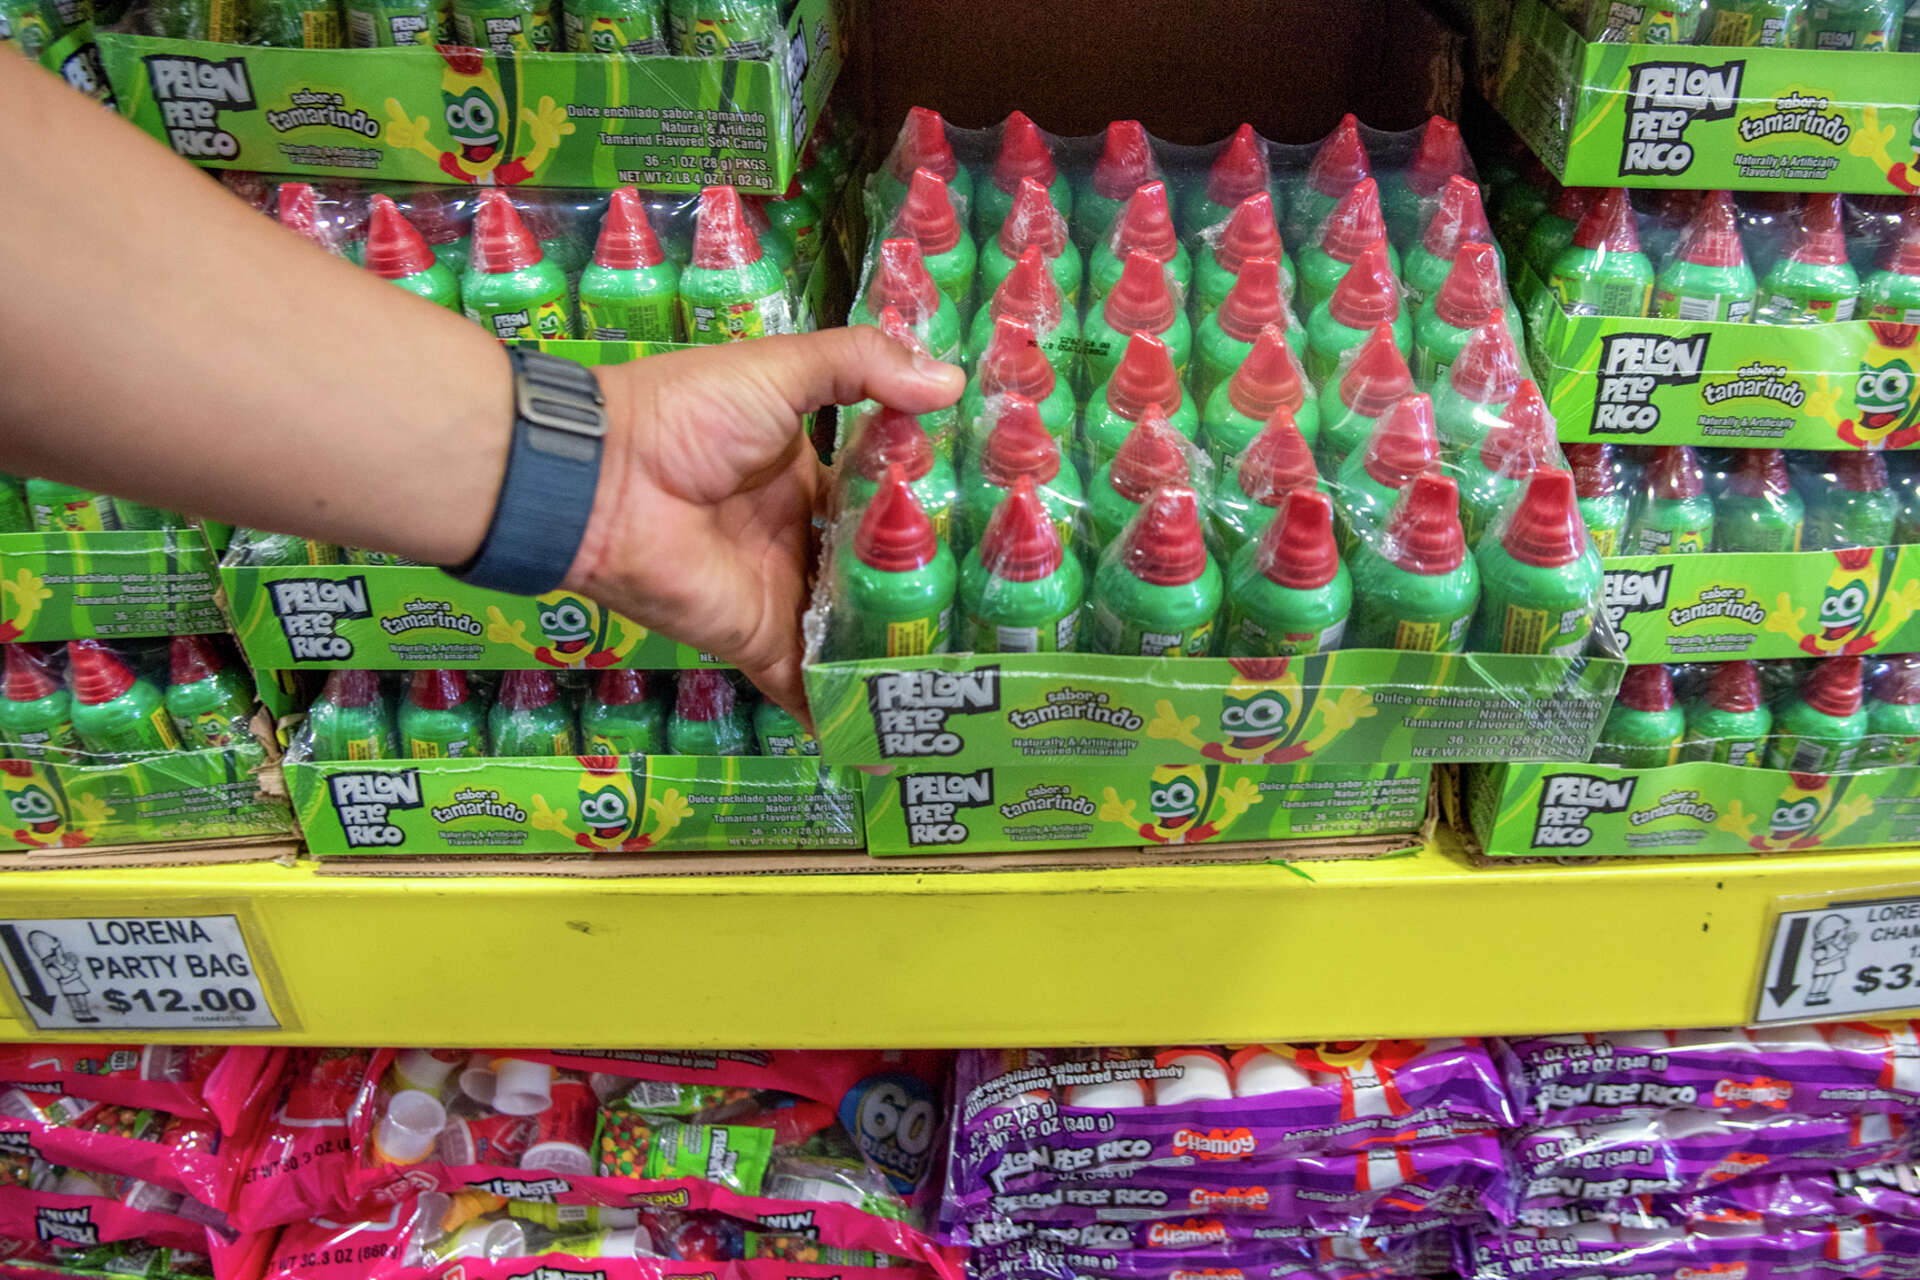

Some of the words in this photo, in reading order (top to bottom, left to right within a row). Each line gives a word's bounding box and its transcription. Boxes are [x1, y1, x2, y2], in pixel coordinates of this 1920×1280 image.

[148, 57, 252, 104] PELON
[1634, 66, 1740, 110] PELON
[292, 89, 327, 105] sabor
[332, 95, 344, 106] a
[1776, 93, 1812, 111] sabor
[1816, 98, 1829, 110] a
[163, 101, 216, 129] PELO
[267, 104, 380, 138] tamarindo
[567, 105, 601, 119] Dulce
[602, 106, 660, 120] enchilado
[662, 108, 694, 121] sabor
[707, 110, 766, 124] tamarindo
[1629, 110, 1688, 140] PELO
[661, 121, 705, 134] Natural
[707, 123, 716, 135] &
[718, 123, 767, 137] Artificial
[1739, 110, 1850, 146] tamarindo
[172, 129, 238, 158] RICO
[600, 133, 653, 146] Tamarind
[655, 134, 706, 147] Flavored
[733, 137, 768, 152] Candy
[644, 156, 660, 168] 36
[680, 157, 697, 168] OZ
[700, 156, 717, 170] (28
[719, 158, 734, 172] g)
[1625, 142, 1692, 171] RICO
[1734, 154, 1779, 169] Naturally
[1790, 156, 1839, 170] Artificially
[619, 171, 642, 183] NET
[644, 171, 663, 183] WT
[665, 172, 674, 184] 2
[676, 172, 692, 184] LB
[703, 173, 720, 185] OZ
[722, 173, 752, 187] (1.02
[755, 174, 773, 189] kg)
[1739, 166, 1783, 178] Flavored
[1784, 168, 1828, 179] Tamarind
[1606, 338, 1705, 376] PELON
[1602, 377, 1655, 402] PELO
[1703, 378, 1805, 408] tamarindo
[1595, 404, 1659, 430] RICO
[275, 580, 368, 614] PELON
[1604, 569, 1668, 606] ELON
[1700, 586, 1733, 600] sabor
[404, 598, 435, 612] sabor
[1669, 600, 1765, 626] tamarindo
[284, 613, 333, 636] PELO
[381, 612, 483, 636] tamarindo
[291, 637, 351, 658] RICO
[877, 670, 996, 711] PELON
[1046, 687, 1092, 704] sabor
[1097, 693, 1109, 704] a
[1373, 692, 1412, 706] Dulce
[1415, 695, 1480, 708] enchilado
[880, 709, 944, 732] PELO
[1008, 701, 1144, 731] tamarindo
[1403, 718, 1463, 729] Tamarind
[1467, 719, 1525, 730] Flavored
[882, 733, 961, 756] RICO
[1012, 737, 1065, 750] Naturally
[1080, 737, 1138, 750] Artificially
[1022, 746, 1073, 756] Flavored
[1076, 746, 1129, 757] Tamarind
[1412, 747, 1438, 757] NET
[1441, 747, 1463, 757] WT
[334, 772, 419, 805] PELON
[455, 788, 485, 800] sabor
[906, 772, 991, 805] PELON
[1026, 784, 1058, 797] sabor
[1546, 777, 1636, 810] PELON
[340, 804, 387, 825] PELO
[432, 801, 526, 823] tamarindo
[909, 804, 955, 824] PELO
[1000, 794, 1096, 819] tamarindo
[1542, 807, 1589, 826] PELO
[347, 825, 403, 846] RICO
[911, 824, 968, 844] RICO
[1535, 827, 1592, 847] RICO
[88, 920, 212, 945] LORENA
[86, 955, 177, 979] PARTY
[185, 953, 249, 977] BAG
[102, 988, 257, 1014] $12.00
[1049, 1061, 1087, 1075] sabor
[1103, 1058, 1156, 1070] chamoy
[1571, 1060, 1590, 1074] 12
[1592, 1058, 1613, 1072] OZ
[1005, 1077, 1053, 1098] chamoy
[1056, 1070, 1112, 1085] flavored
[1115, 1068, 1141, 1081] soft
[1144, 1065, 1184, 1080] candy
[1642, 1084, 1697, 1104] RICO
[861, 1082, 935, 1154] 60
[992, 1112, 1014, 1131] OZ
[1015, 1106, 1039, 1125] (28
[1042, 1100, 1057, 1116] g)
[1019, 1125, 1037, 1140] 12
[1040, 1119, 1061, 1136] OZ
[1063, 1115, 1095, 1132] (340
[1098, 1113, 1115, 1131] g)
[314, 1141, 332, 1156] OZ
[1054, 1149, 1094, 1170] PELO
[1098, 1140, 1152, 1162] RICO
[1116, 1190, 1168, 1205] RICO
[334, 1249, 353, 1264] OZ
